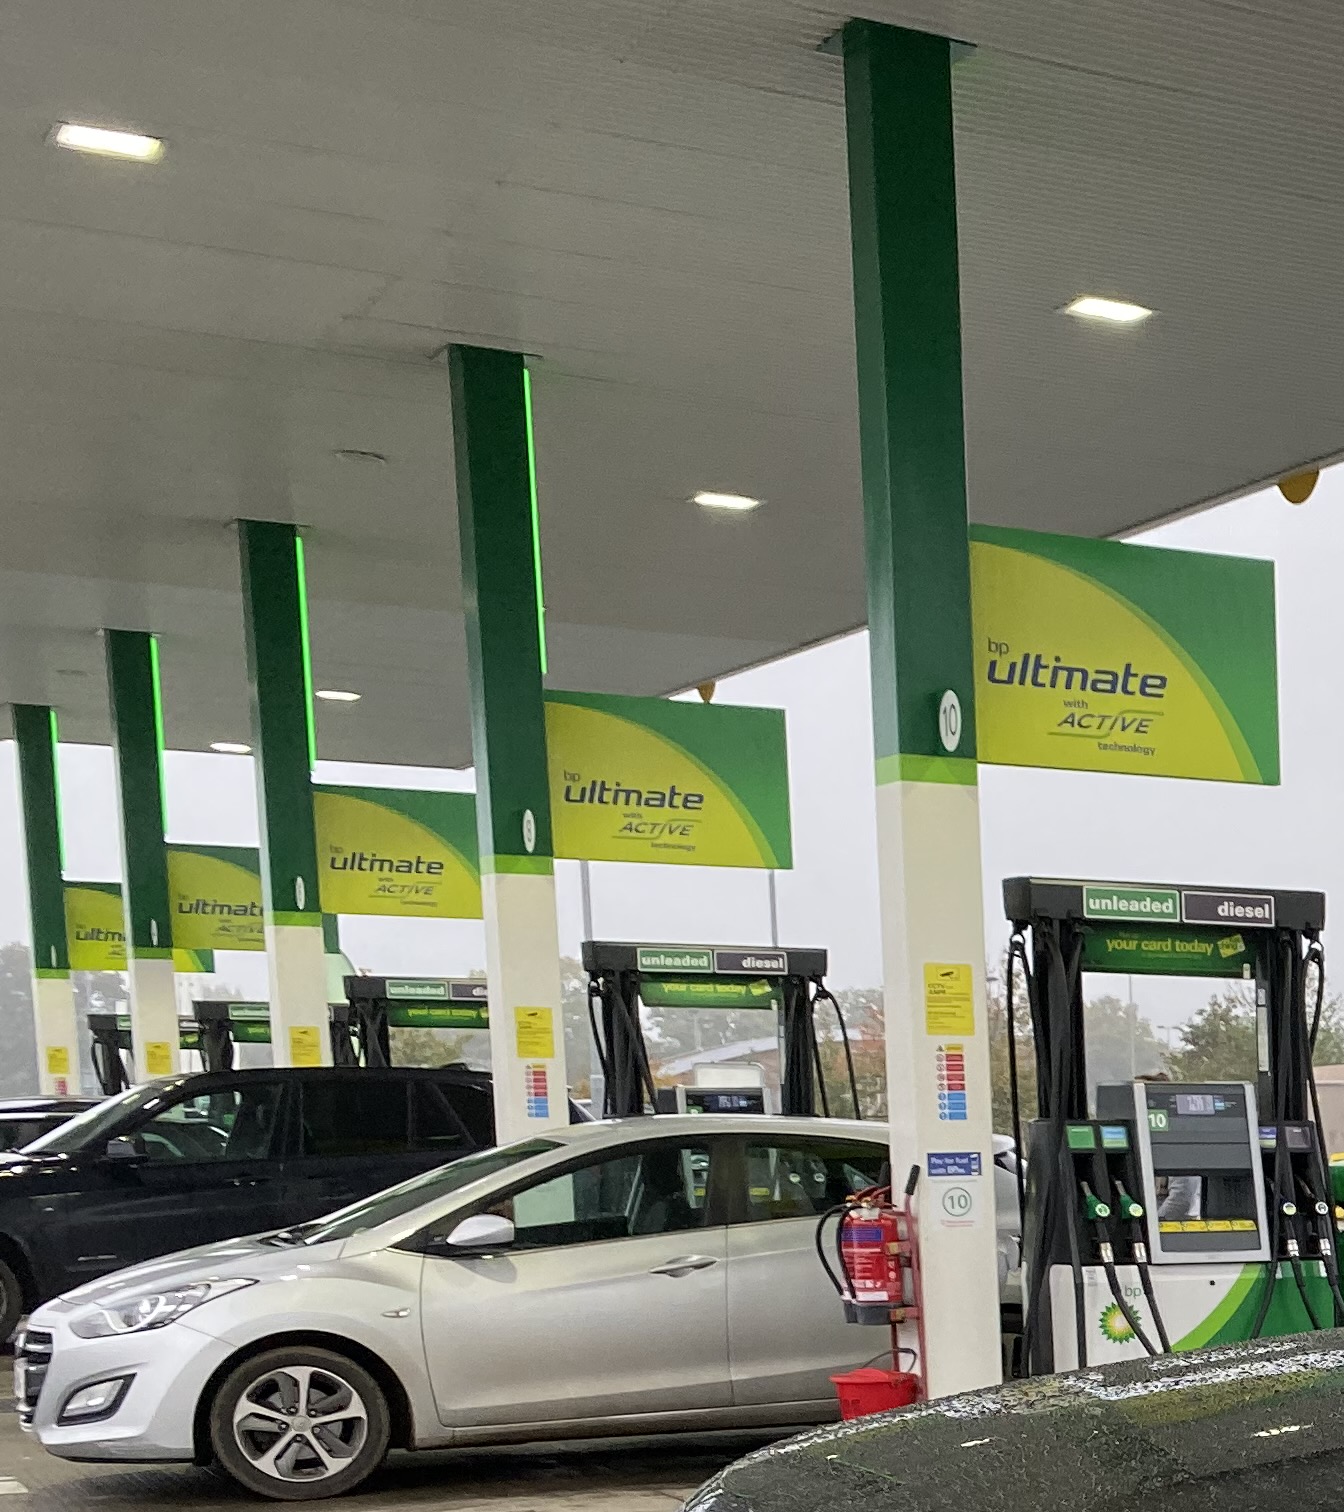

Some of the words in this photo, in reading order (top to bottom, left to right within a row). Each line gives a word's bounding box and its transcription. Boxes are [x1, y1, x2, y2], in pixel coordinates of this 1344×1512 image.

[988, 637, 1009, 656] bp
[987, 653, 1168, 698] ultimate
[1063, 700, 1088, 709] with
[942, 703, 958, 737] 10
[1057, 713, 1153, 734] ACTIVE
[1097, 741, 1156, 756] technology
[563, 780, 704, 810] ultimate
[619, 822, 694, 836] ACTIVE
[329, 852, 444, 876] ultimate
[178, 899, 263, 917] ultimat
[1088, 895, 1174, 914] unleaded
[1217, 901, 1270, 919] diesel
[75, 928, 126, 942] ultim
[1106, 938, 1138, 952] your
[1141, 938, 1171, 951] card
[1175, 939, 1214, 956] today
[641, 955, 709, 967] unleaded
[742, 956, 784, 969] diesel
[1148, 1113, 1167, 1128] 10
[947, 1194, 968, 1209] 10
[1124, 1285, 1141, 1299] bp
